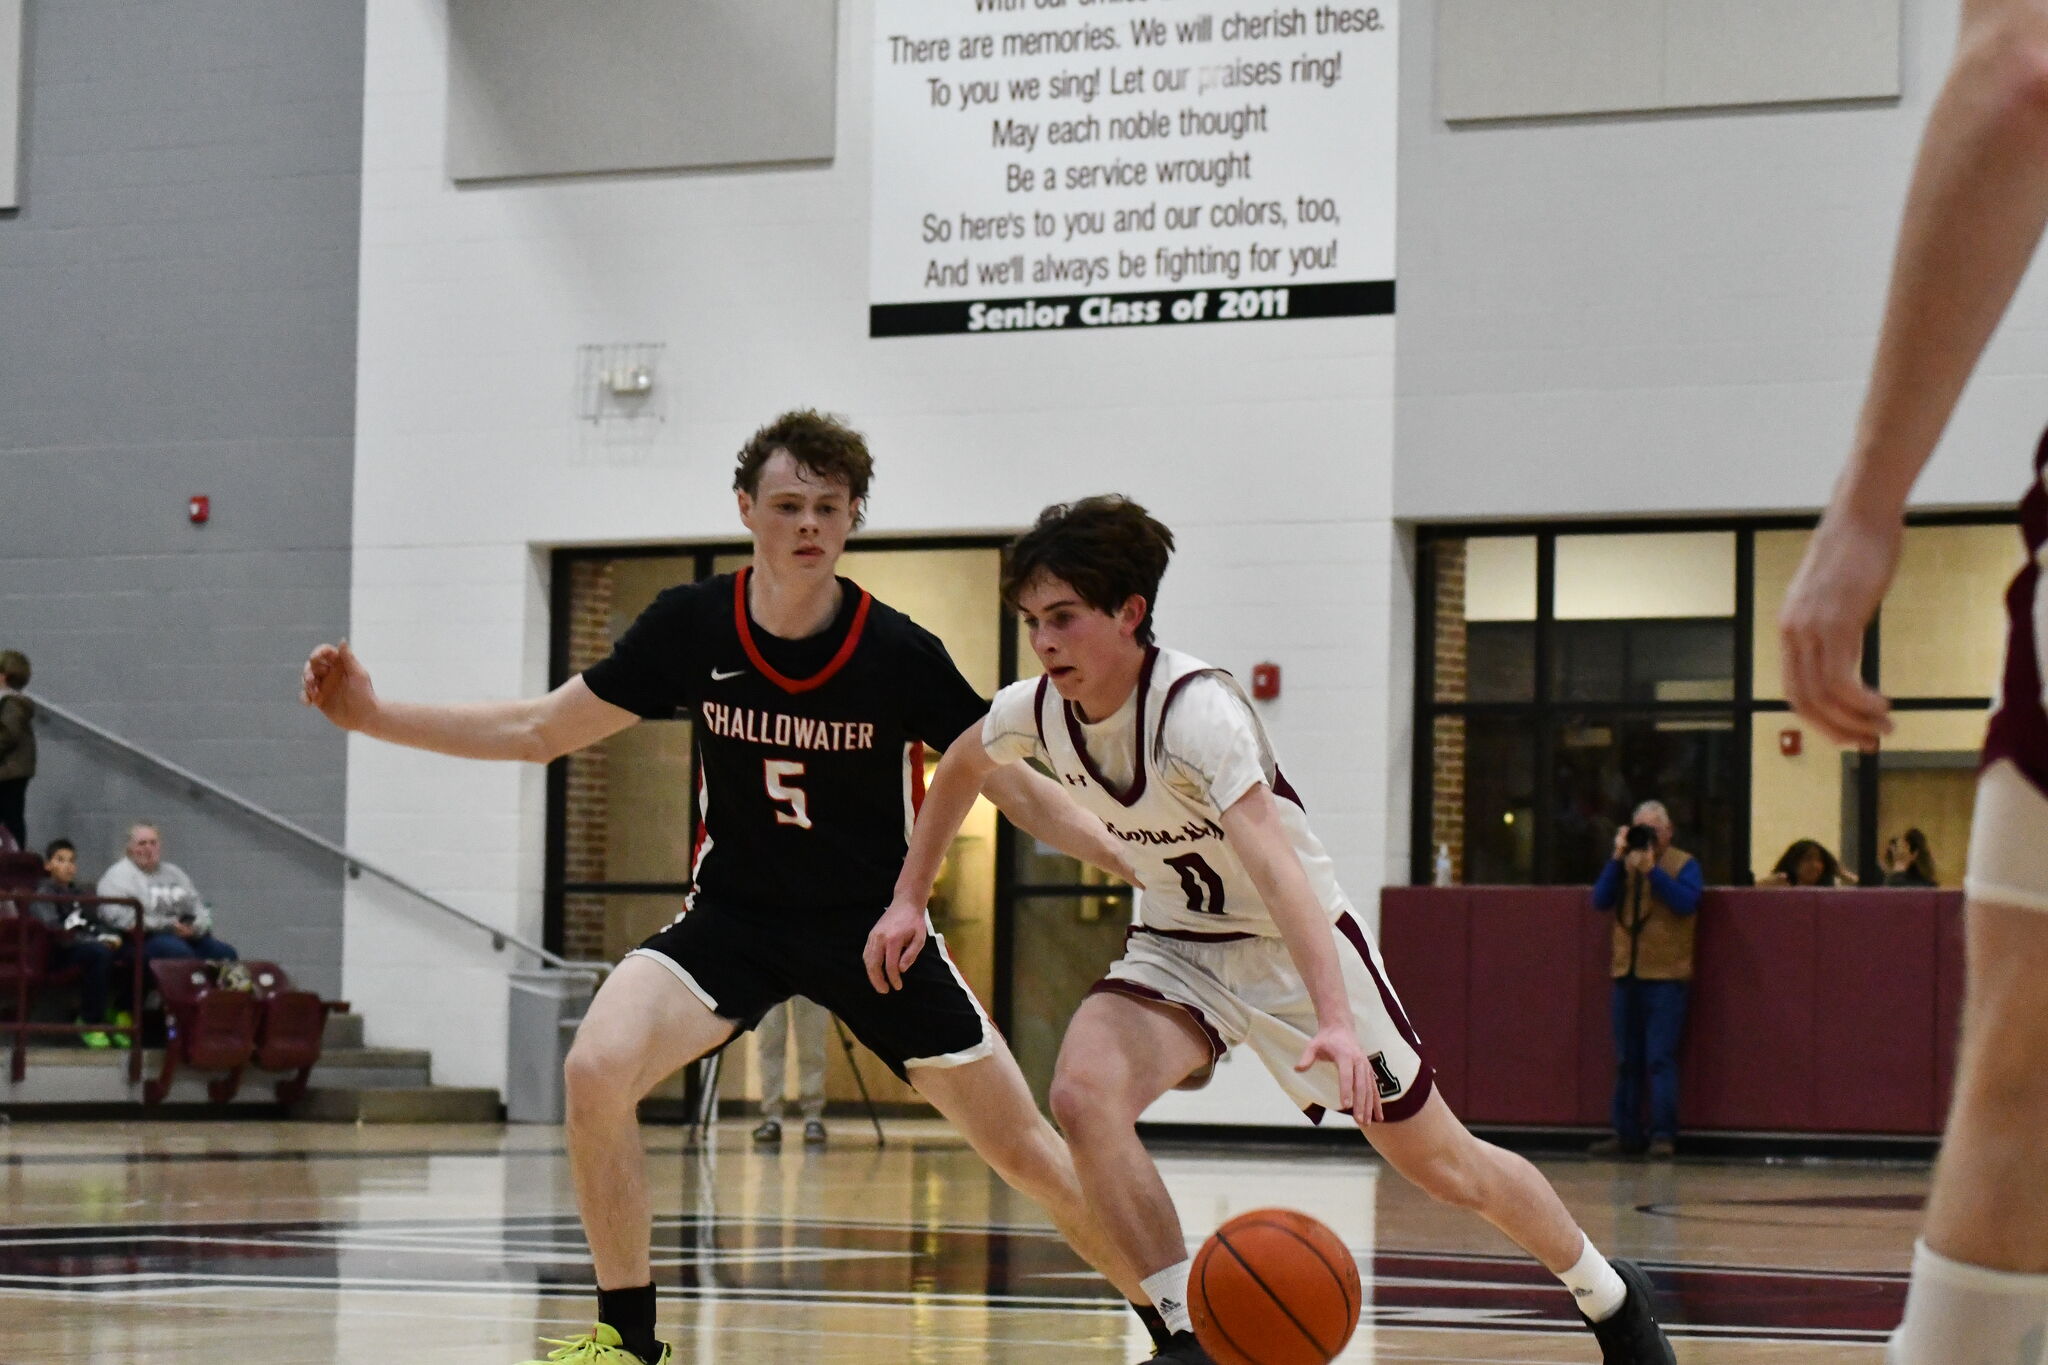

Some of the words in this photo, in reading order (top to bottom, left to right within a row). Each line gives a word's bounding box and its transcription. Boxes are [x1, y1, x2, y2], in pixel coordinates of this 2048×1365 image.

[888, 35, 950, 64] There
[958, 35, 994, 60] are
[1002, 22, 1121, 56] memories.
[1130, 18, 1167, 47] We
[1175, 15, 1213, 44] will
[1221, 7, 1306, 42] cherish
[1315, 5, 1384, 35] these.
[926, 77, 951, 107] To
[959, 81, 999, 111] you
[1008, 77, 1040, 101] we
[1049, 67, 1100, 103] sing!
[1110, 66, 1145, 95] Let
[1153, 68, 1190, 93] our
[1291, 51, 1342, 88] ring!
[992, 118, 1039, 153] May
[1047, 114, 1100, 145] each
[1109, 109, 1171, 140] noble
[1179, 104, 1267, 140] thought
[1006, 163, 1035, 193] Be
[1043, 167, 1056, 191] a
[1065, 158, 1147, 190] service
[1155, 151, 1251, 188] wrought
[922, 213, 952, 244] So
[960, 212, 1025, 241] here's
[1033, 210, 1056, 237] to
[1064, 212, 1105, 242] you
[1113, 202, 1156, 233] and
[1164, 206, 1202, 231] our
[1210, 197, 1287, 228] colors,
[1296, 195, 1340, 224] too,
[924, 258, 969, 288] And
[977, 255, 1024, 286] we'll
[1032, 254, 1110, 287] always
[1118, 250, 1147, 279] be
[1155, 245, 1240, 283] fighting
[1249, 242, 1282, 272] for
[1289, 239, 1338, 277] you!
[968, 301, 1069, 330] Senior
[1080, 295, 1161, 325] Class
[1172, 292, 1207, 321] of
[1218, 289, 1288, 318] 2011
[702, 701, 874, 751] SHALLOWATER
[763, 758, 813, 830] 5
